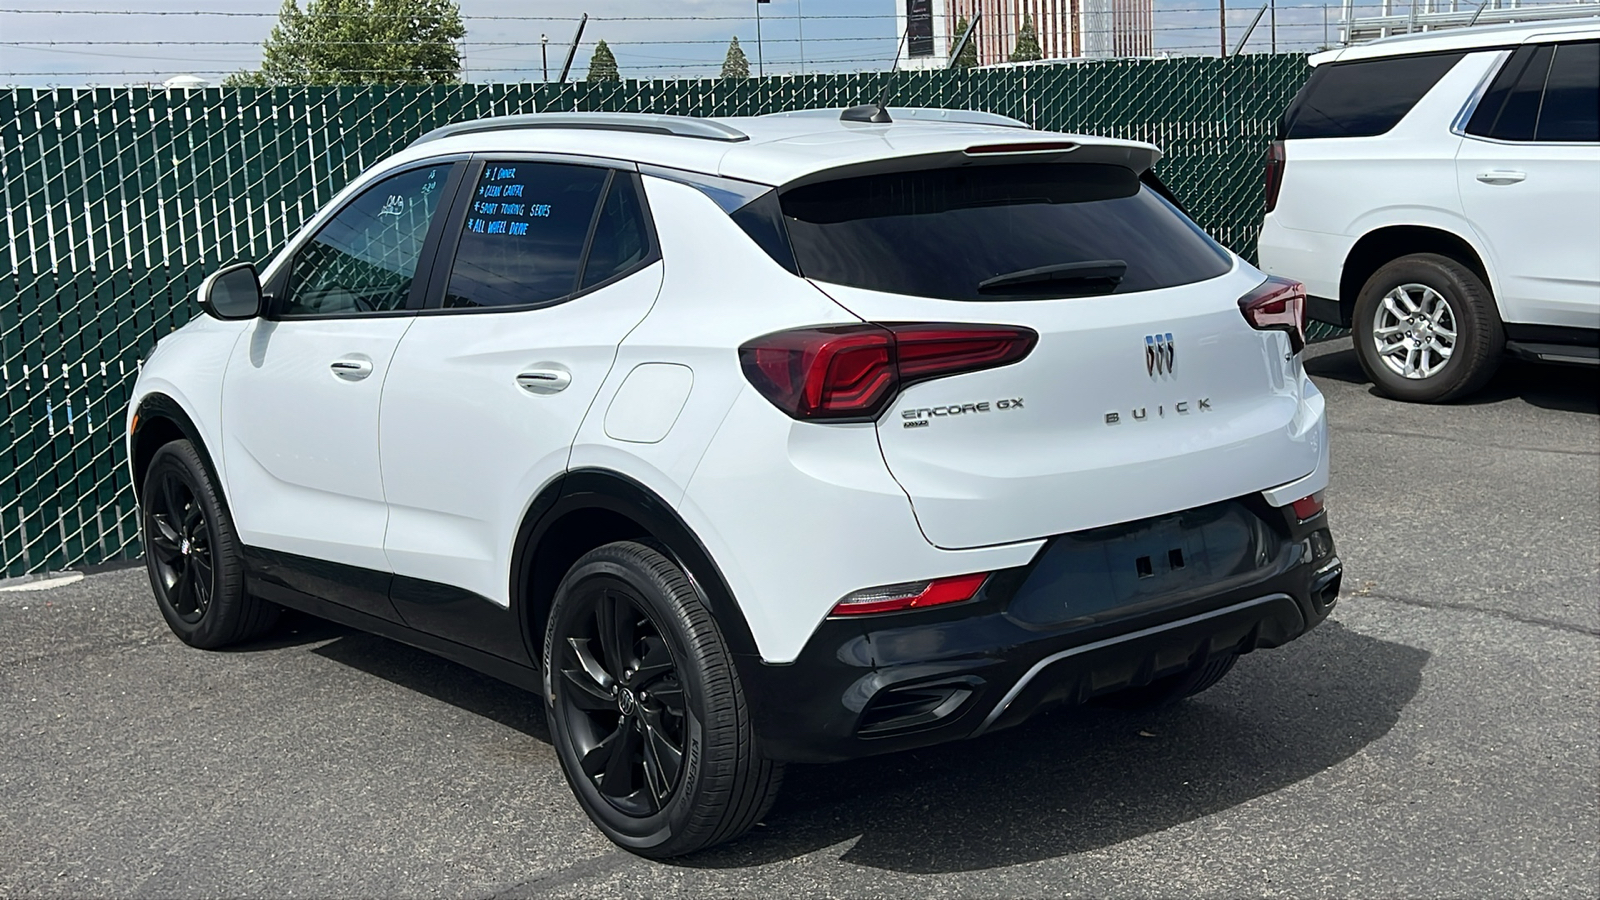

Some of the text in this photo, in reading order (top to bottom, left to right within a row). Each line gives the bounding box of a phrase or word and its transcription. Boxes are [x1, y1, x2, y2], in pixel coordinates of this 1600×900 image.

[484, 185, 524, 198] CLEAN CARFAX
[479, 202, 552, 218] SPORT TOURING SERIES
[472, 218, 529, 235] ALL WHEEL DRIVE
[901, 397, 1025, 420] ENCORE GX
[1105, 397, 1212, 425] BUICK
